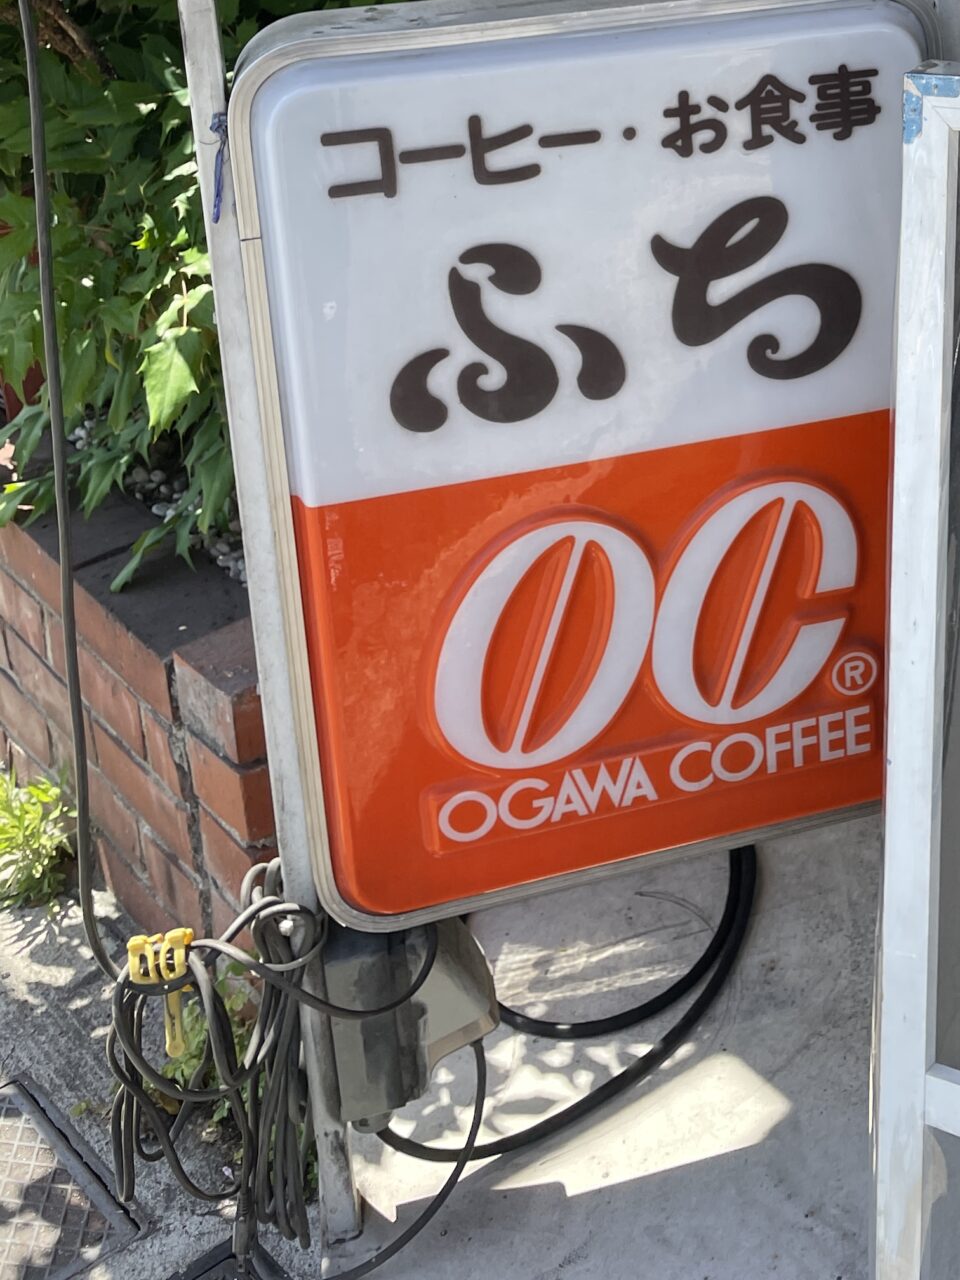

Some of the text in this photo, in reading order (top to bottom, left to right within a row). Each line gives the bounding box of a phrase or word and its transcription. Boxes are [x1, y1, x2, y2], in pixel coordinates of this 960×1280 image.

[390, 196, 862, 433] ふち
[434, 481, 858, 770] OC
[437, 705, 872, 843] OGAWA COFFEE
